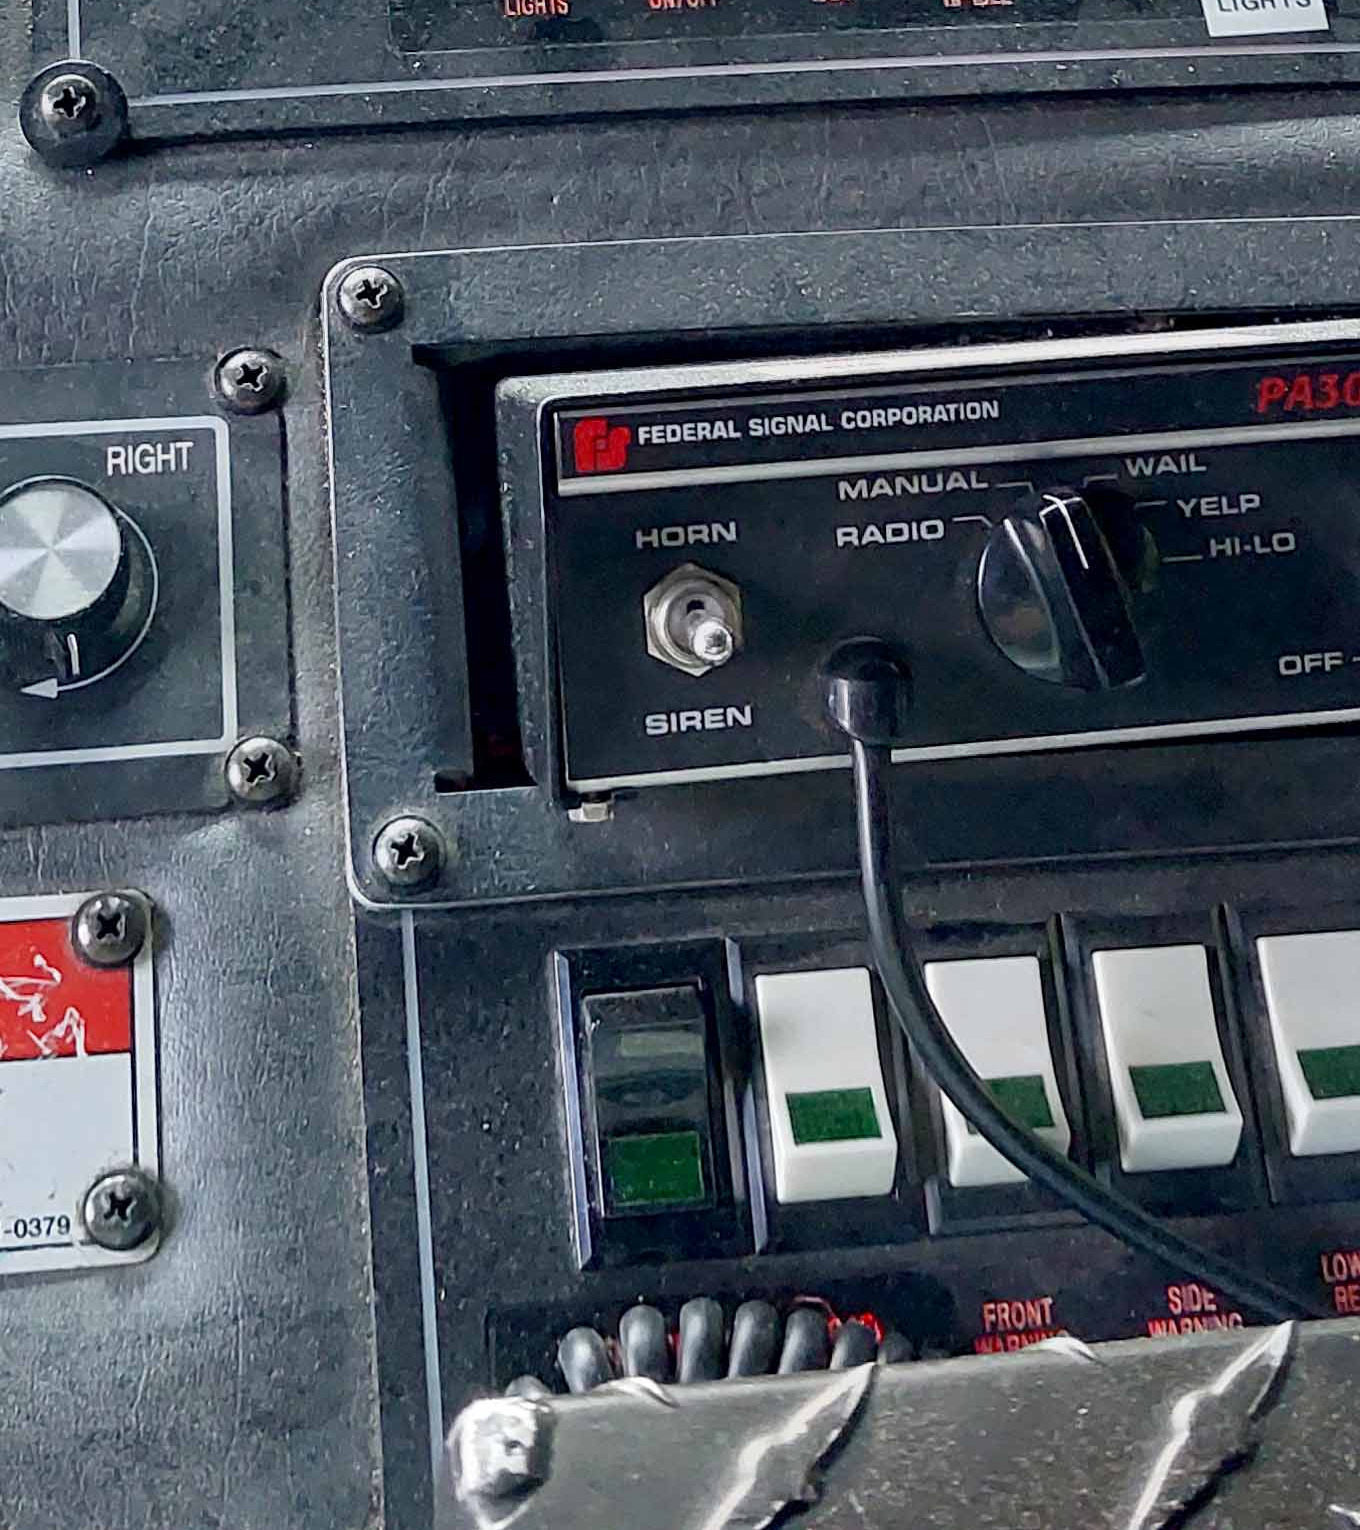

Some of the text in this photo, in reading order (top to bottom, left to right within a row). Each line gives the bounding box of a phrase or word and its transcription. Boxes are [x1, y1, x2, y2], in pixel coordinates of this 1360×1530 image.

[638, 418, 740, 446] FEDERAL
[749, 413, 834, 437] SIGNAL
[841, 400, 1000, 430] CORPORATION
[107, 441, 194, 476] RIGHT
[1126, 452, 1206, 478] WAIL
[839, 470, 989, 501] MANUAL
[1177, 493, 1261, 519] YELP
[636, 521, 737, 549] HORN
[836, 519, 945, 547] RADIO
[1210, 532, 1295, 559] HI-LO
[1278, 651, 1343, 677] OFF
[646, 704, 753, 736] SIREN
[1168, 1284, 1217, 1315] SIDE
[983, 1297, 1053, 1333] FRONT
